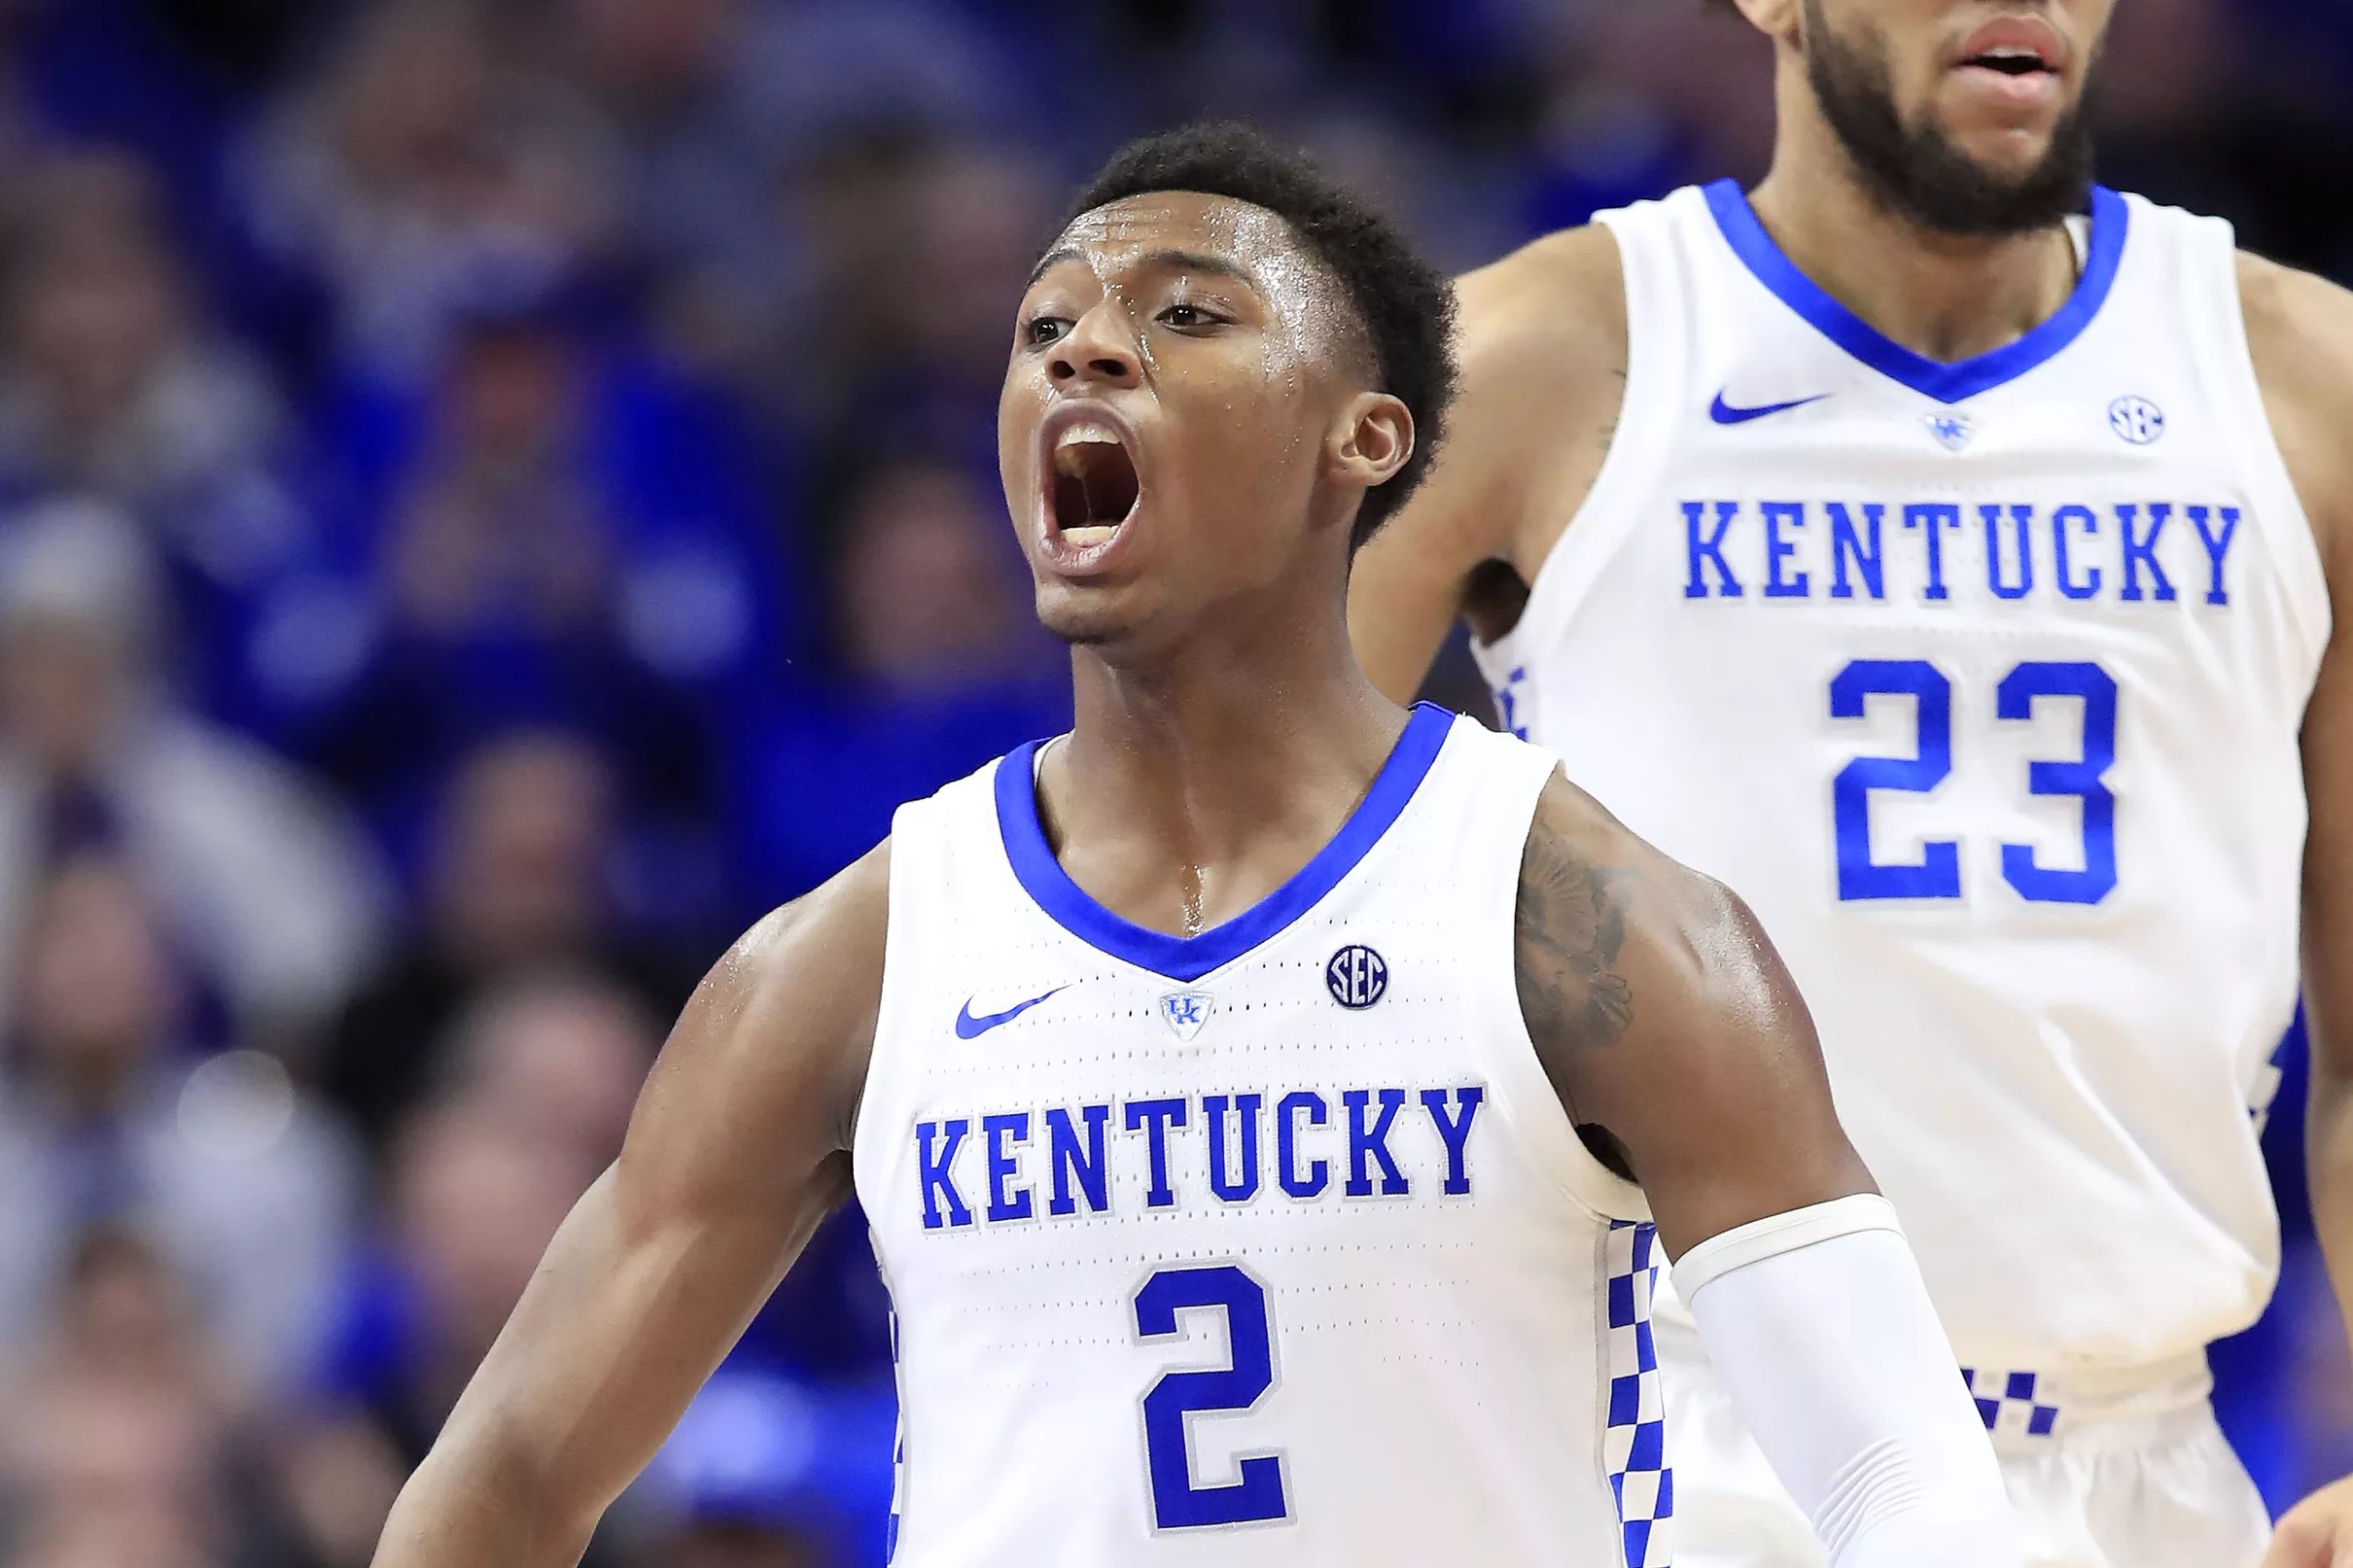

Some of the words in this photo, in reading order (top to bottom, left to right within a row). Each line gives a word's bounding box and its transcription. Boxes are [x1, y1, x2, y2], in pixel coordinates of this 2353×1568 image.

[1680, 501, 2239, 606] KENTUCKY
[1829, 658, 2117, 905] 23
[1168, 998, 1201, 1025] UK
[1329, 948, 1385, 1004] SEC
[915, 1086, 1484, 1230] KENTUCKY
[1134, 1264, 1288, 1530] 2
